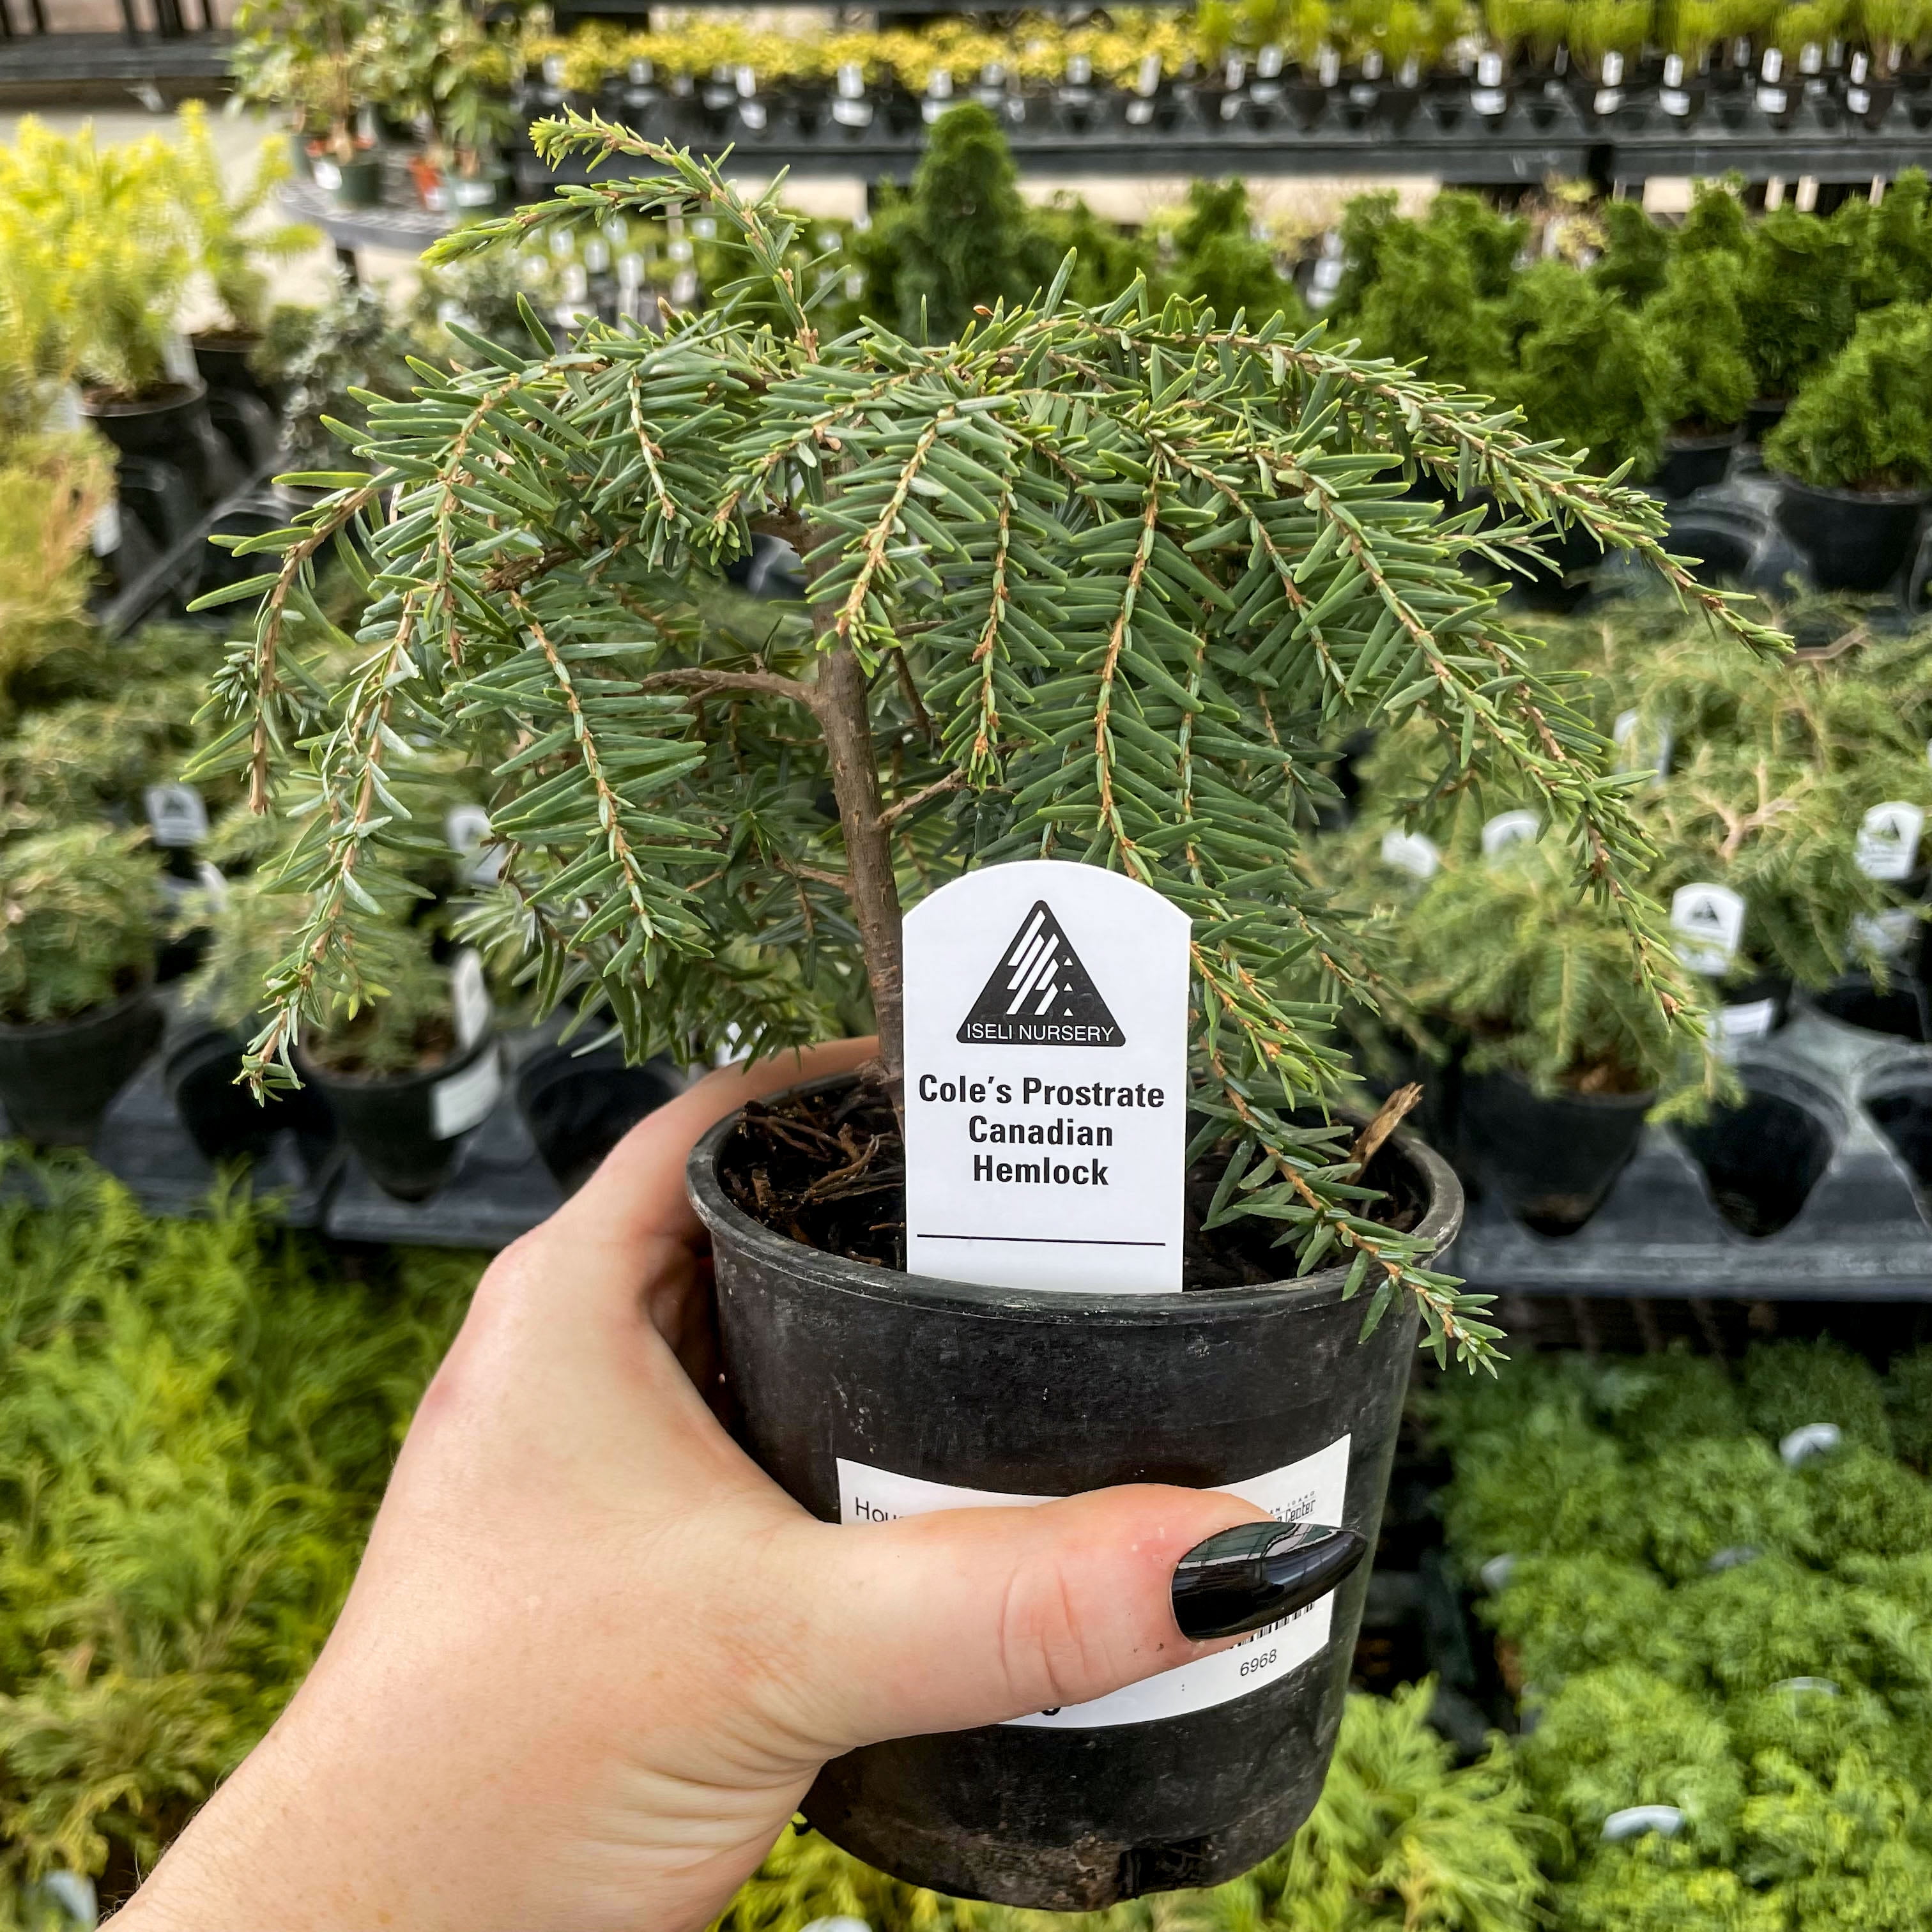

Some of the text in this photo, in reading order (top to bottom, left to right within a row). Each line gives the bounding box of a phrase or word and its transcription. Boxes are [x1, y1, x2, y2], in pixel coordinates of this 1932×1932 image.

[967, 1023, 1116, 1042] ISELI NURSERY
[919, 1074, 1165, 1108] Cole's Prostrate
[969, 1116, 1113, 1146] Canadian
[973, 1154, 1109, 1185] Hemlock
[1239, 1648, 1277, 1676] 6968
